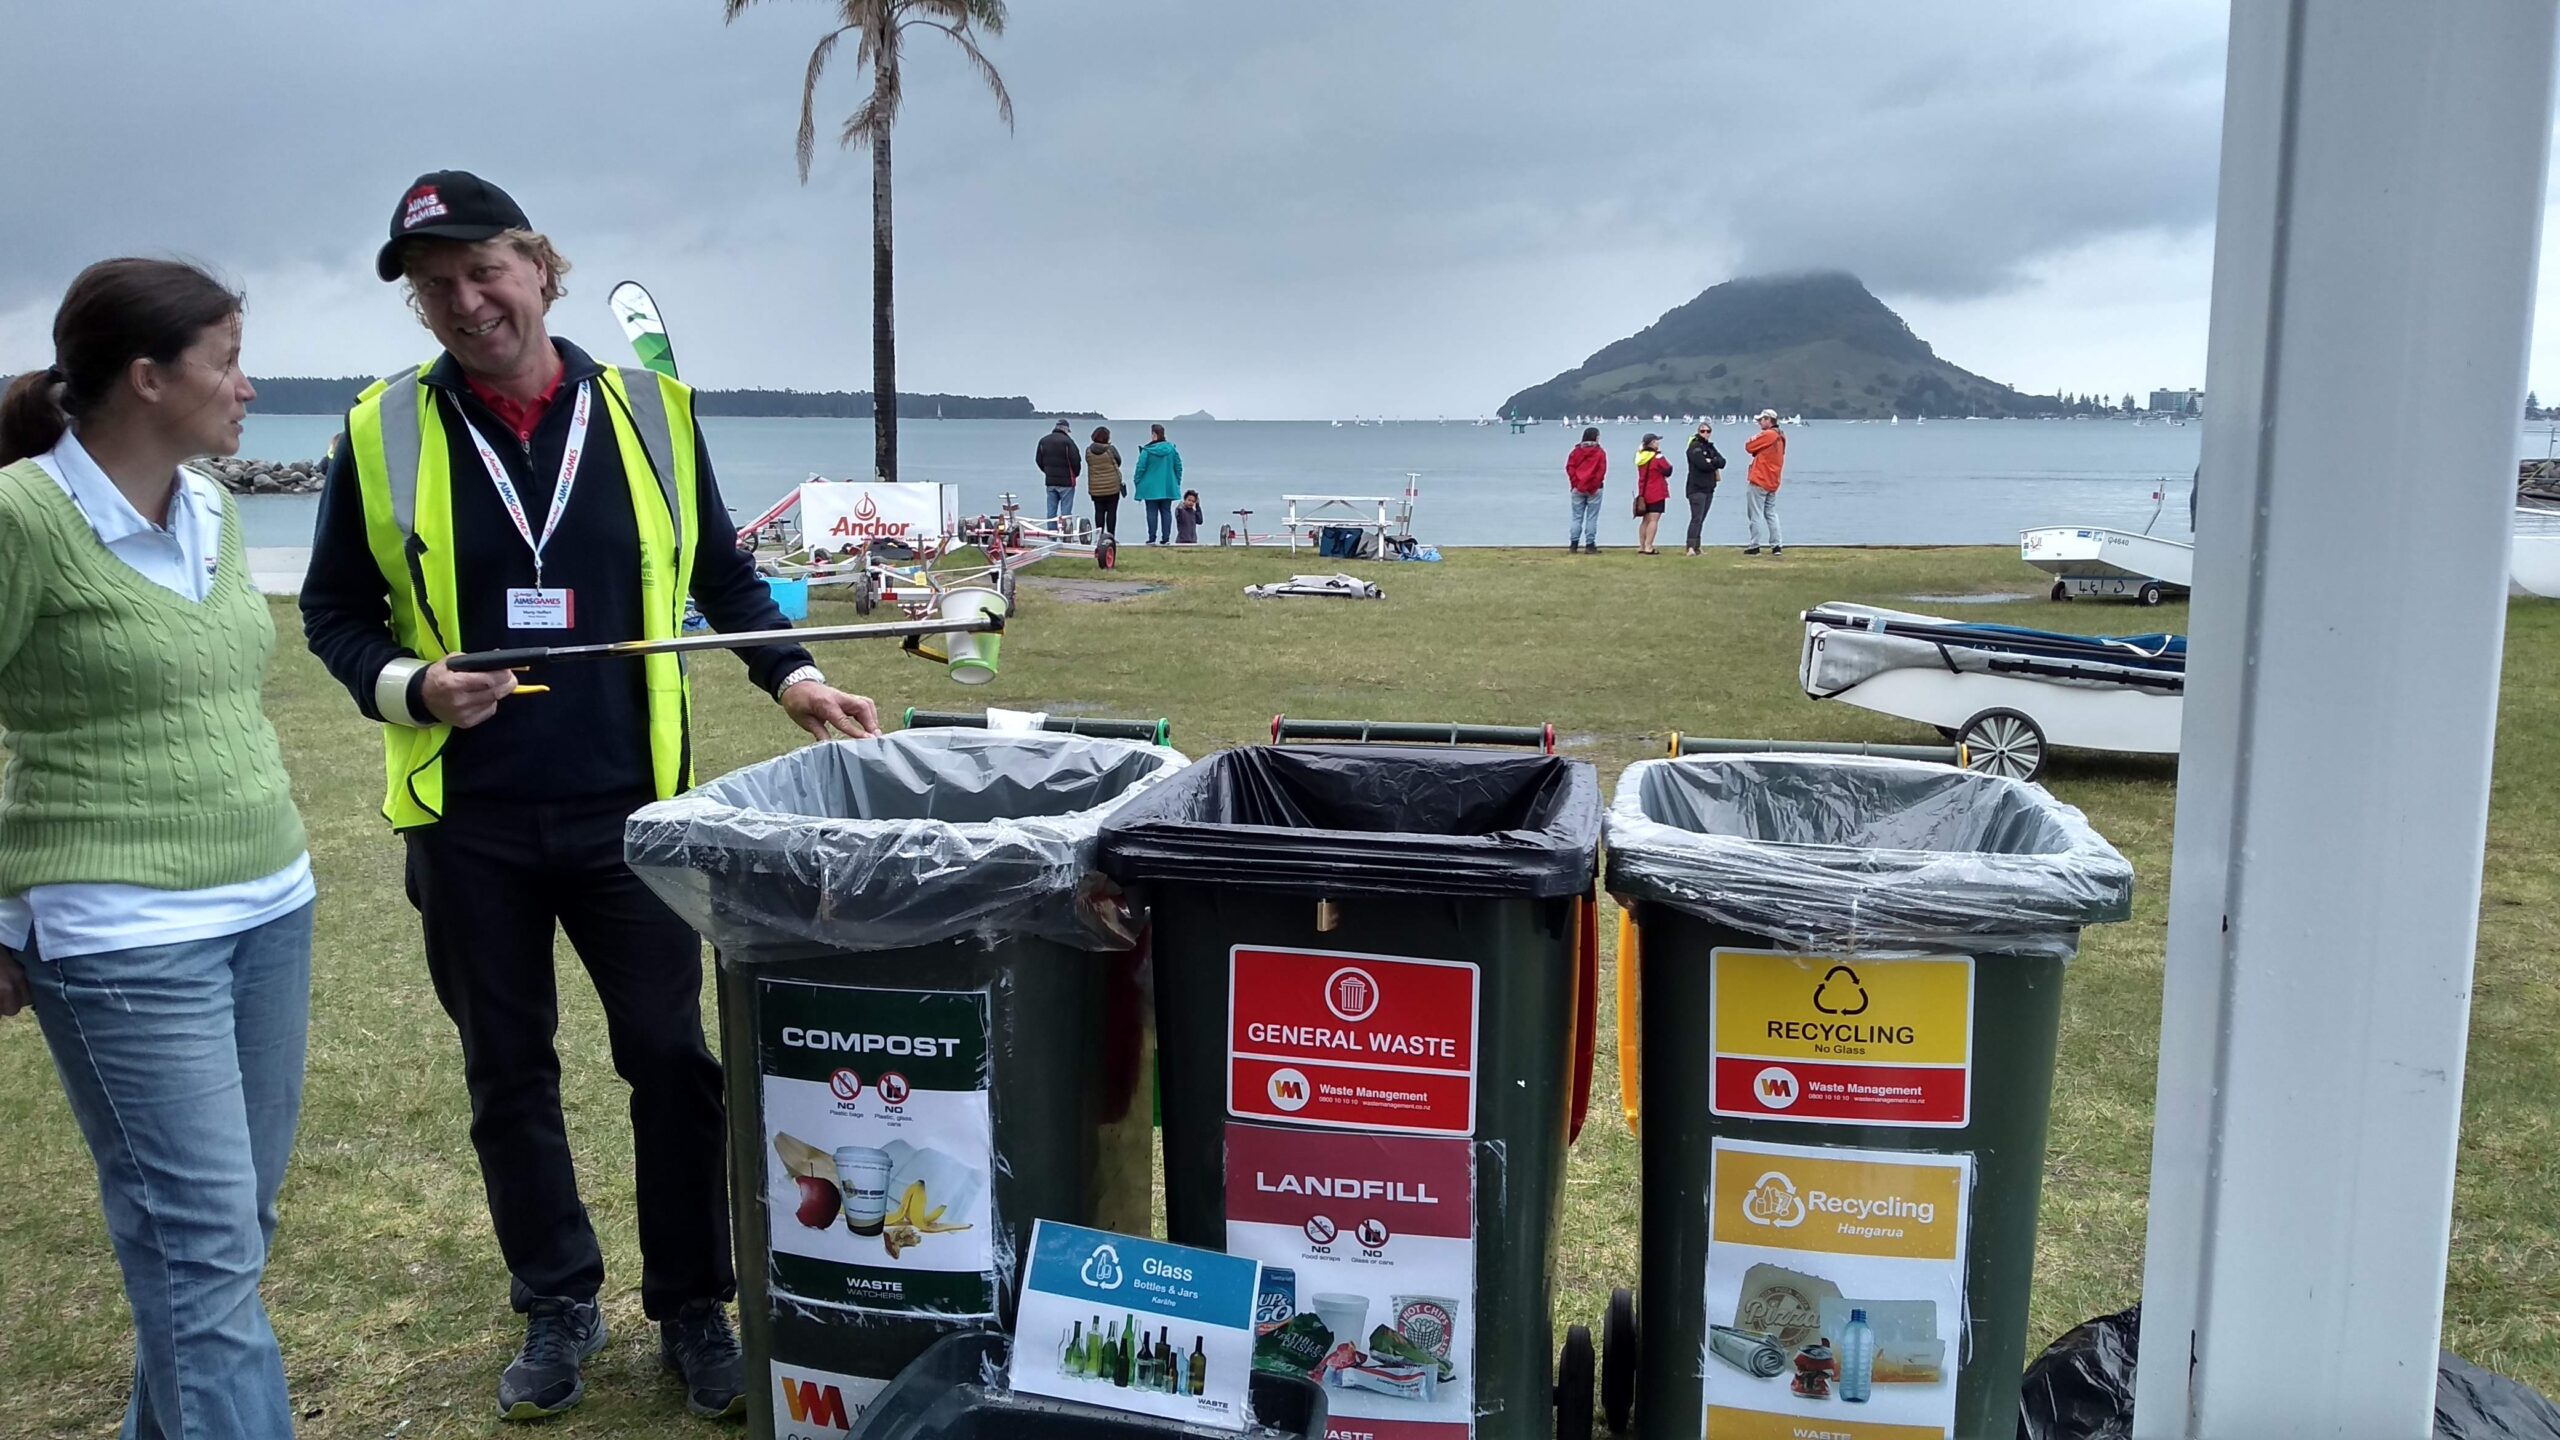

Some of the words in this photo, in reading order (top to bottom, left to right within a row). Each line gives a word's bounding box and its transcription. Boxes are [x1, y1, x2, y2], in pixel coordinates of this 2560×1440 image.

[407, 194, 439, 215] AIMS
[404, 203, 448, 228] GAMES
[829, 516, 910, 536] Anchor
[782, 1026, 960, 1058] COMPOST
[1248, 1022, 1363, 1051] GENERAL
[1369, 1032, 1456, 1058] WASTE
[1767, 1020, 1914, 1045] RECYCLING
[1814, 1043, 1831, 1054] No
[1833, 1044, 1866, 1056] Glass
[1319, 1083, 1354, 1096] Waste
[1356, 1086, 1428, 1102] Management
[1809, 1081, 1844, 1092] Waste
[1847, 1083, 1922, 1096] Management
[837, 1101, 856, 1111] NO
[884, 1105, 904, 1114] NO
[1256, 1171, 1439, 1204] LANDFILL
[1808, 1190, 1934, 1224] Recycling
[1837, 1222, 1904, 1239] Hangarua
[1311, 1245, 1331, 1254] NO
[1319, 1254, 1341, 1262] scraps
[1362, 1249, 1383, 1258] NO
[1142, 1257, 1193, 1282] Glass
[846, 1276, 903, 1292] WASTE
[1133, 1278, 1166, 1293] Bottles
[1168, 1285, 1176, 1295] &
[1177, 1287, 1199, 1299] Jars
[846, 1288, 904, 1300] WATCHERS
[1256, 1304, 1293, 1323] GO
[1402, 1304, 1421, 1320] HOT
[1423, 1304, 1449, 1326] CHIPS
[1198, 1397, 1229, 1408] WASTE
[1323, 1429, 1374, 1440] ASTE
